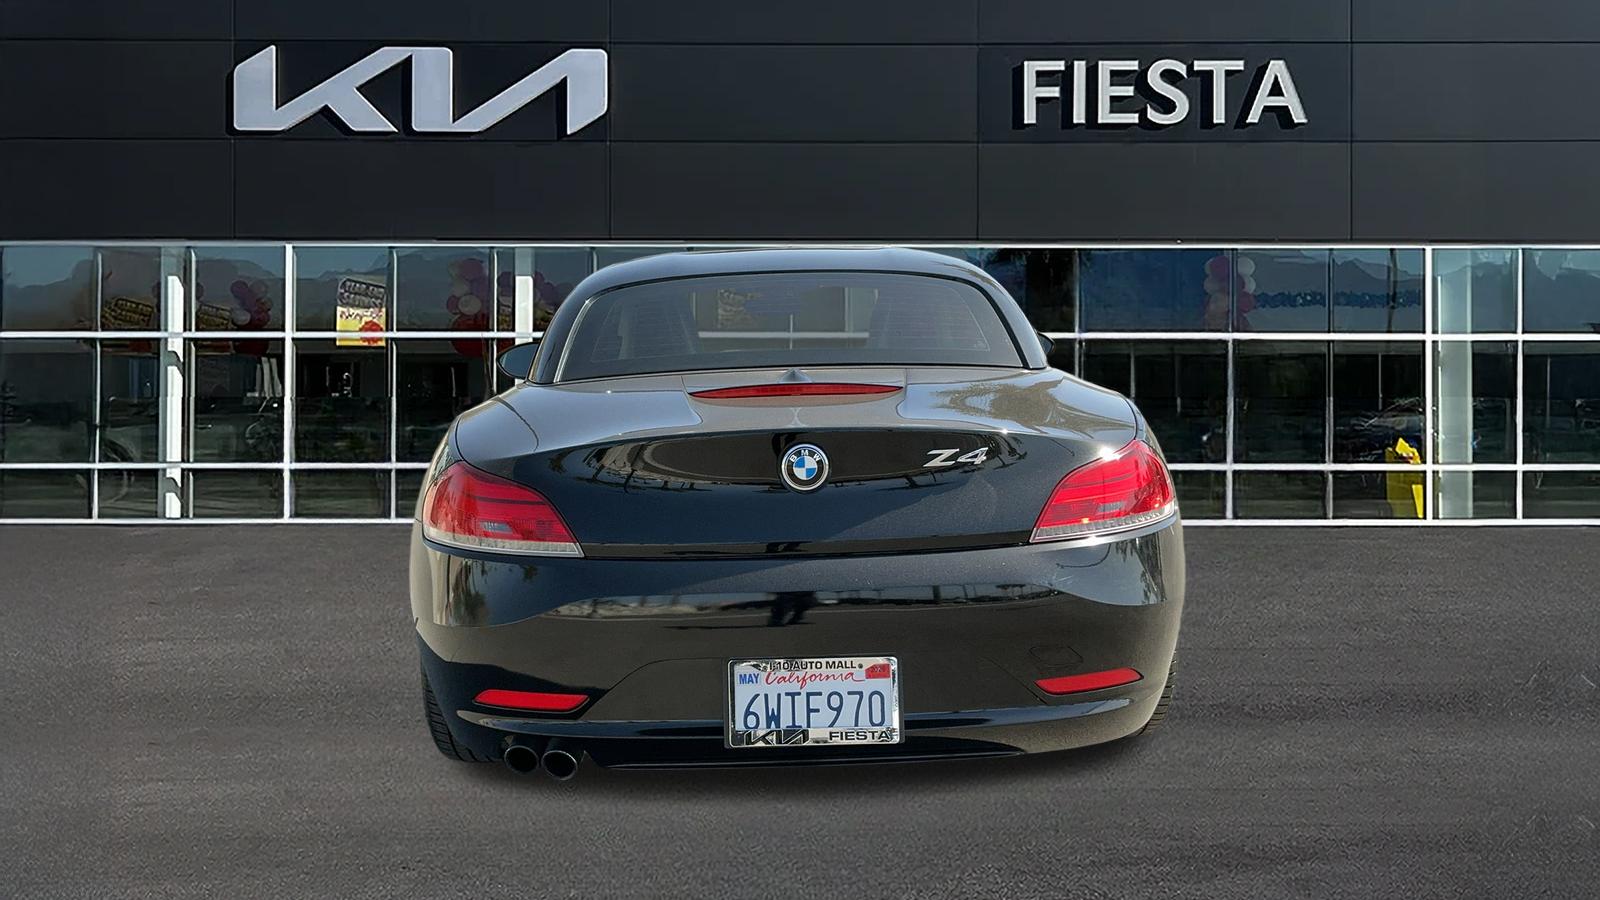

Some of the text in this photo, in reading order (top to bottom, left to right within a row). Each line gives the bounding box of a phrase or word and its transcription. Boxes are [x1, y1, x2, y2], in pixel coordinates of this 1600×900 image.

[234, 45, 608, 135] KIA
[1023, 59, 1308, 125] FIESTA
[790, 449, 821, 463] BMW
[923, 447, 988, 467] Z4
[792, 661, 823, 671] AUTO
[825, 660, 856, 670] MALL
[739, 673, 760, 685] MAY
[765, 670, 866, 690] California
[743, 690, 886, 729] 6WIF970
[744, 729, 810, 745] KIA
[829, 730, 890, 742] FIESTA
